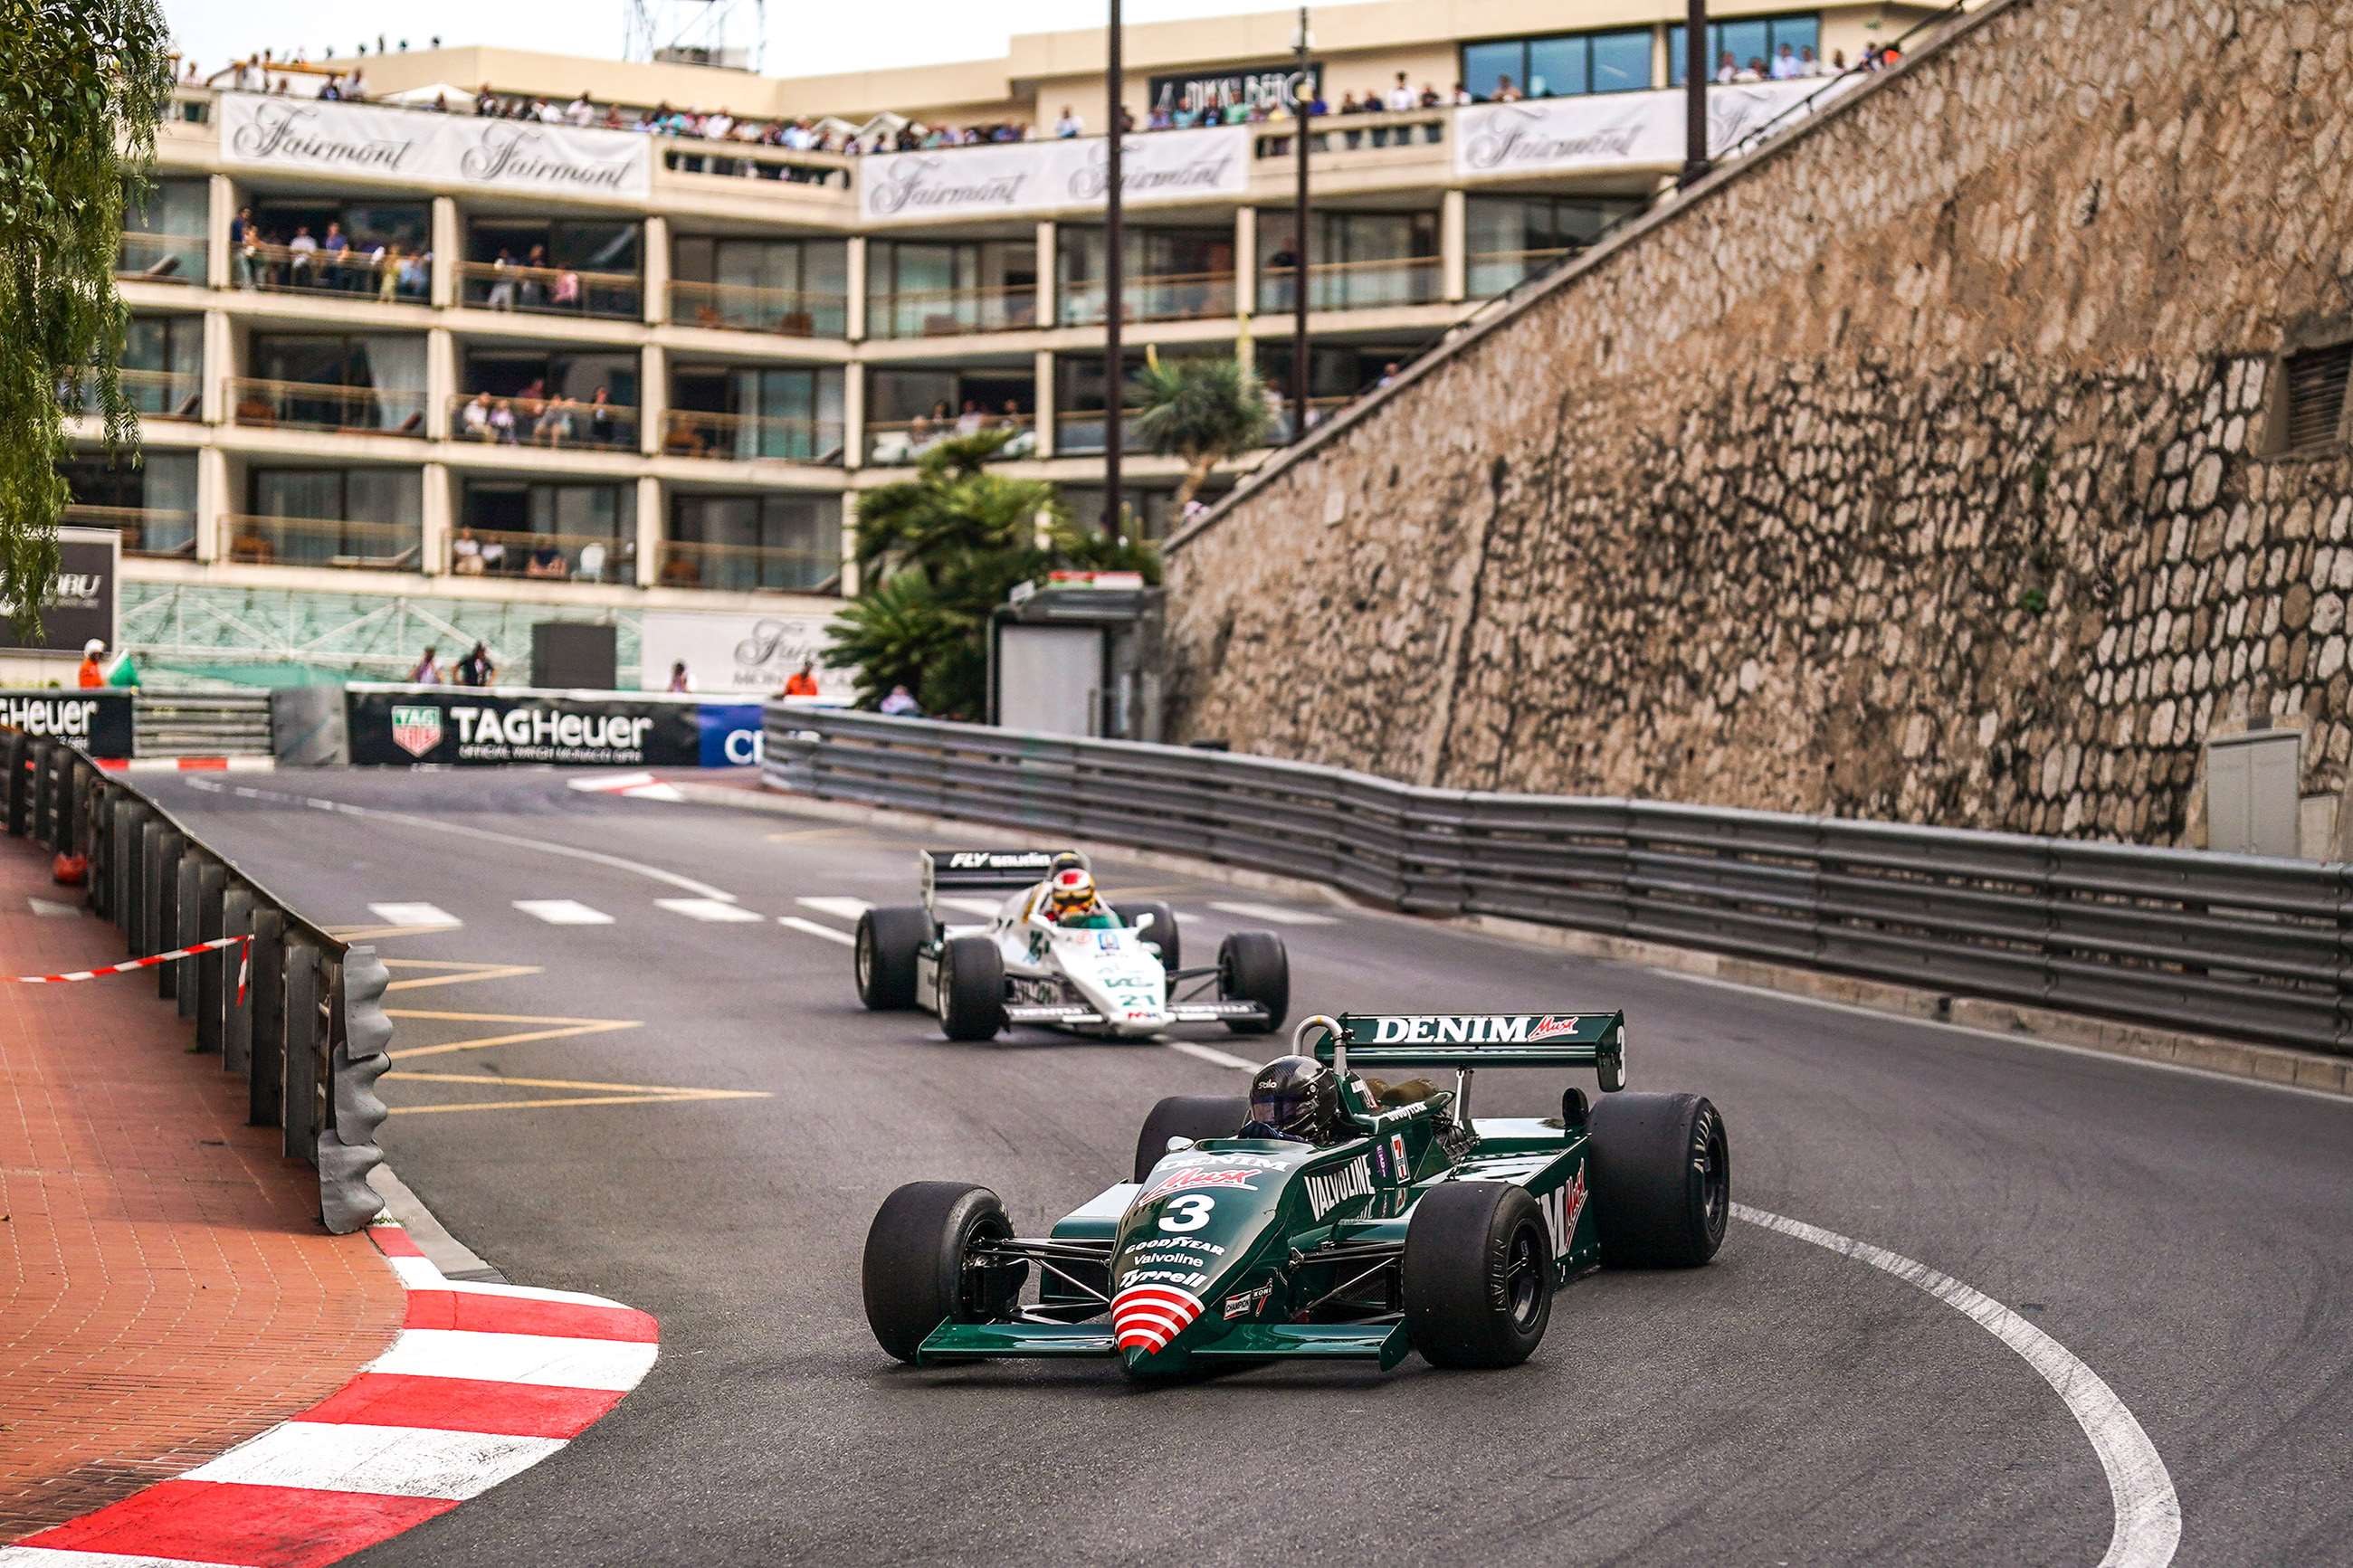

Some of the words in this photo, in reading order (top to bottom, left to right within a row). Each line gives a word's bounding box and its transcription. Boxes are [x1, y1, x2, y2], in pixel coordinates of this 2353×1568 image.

[233, 99, 414, 171] Fairmont
[461, 121, 634, 188] Fairmont
[870, 156, 1028, 214] Fairmont
[1068, 141, 1232, 199] Firmont
[0, 697, 99, 736] Heuer
[397, 709, 434, 725] TAG
[450, 707, 654, 748] TAGHeuer
[950, 852, 990, 868] FLY
[1372, 1017, 1531, 1043] DENIM
[1157, 1155, 1292, 1173] DENIM
[1304, 1153, 1376, 1222] VALVOLINE
[1158, 1193, 1215, 1232] 3
[1125, 1236, 1225, 1256] GOODYEAR
[1134, 1253, 1204, 1267] Valvoline
[1119, 1269, 1207, 1288] Tyrrell
